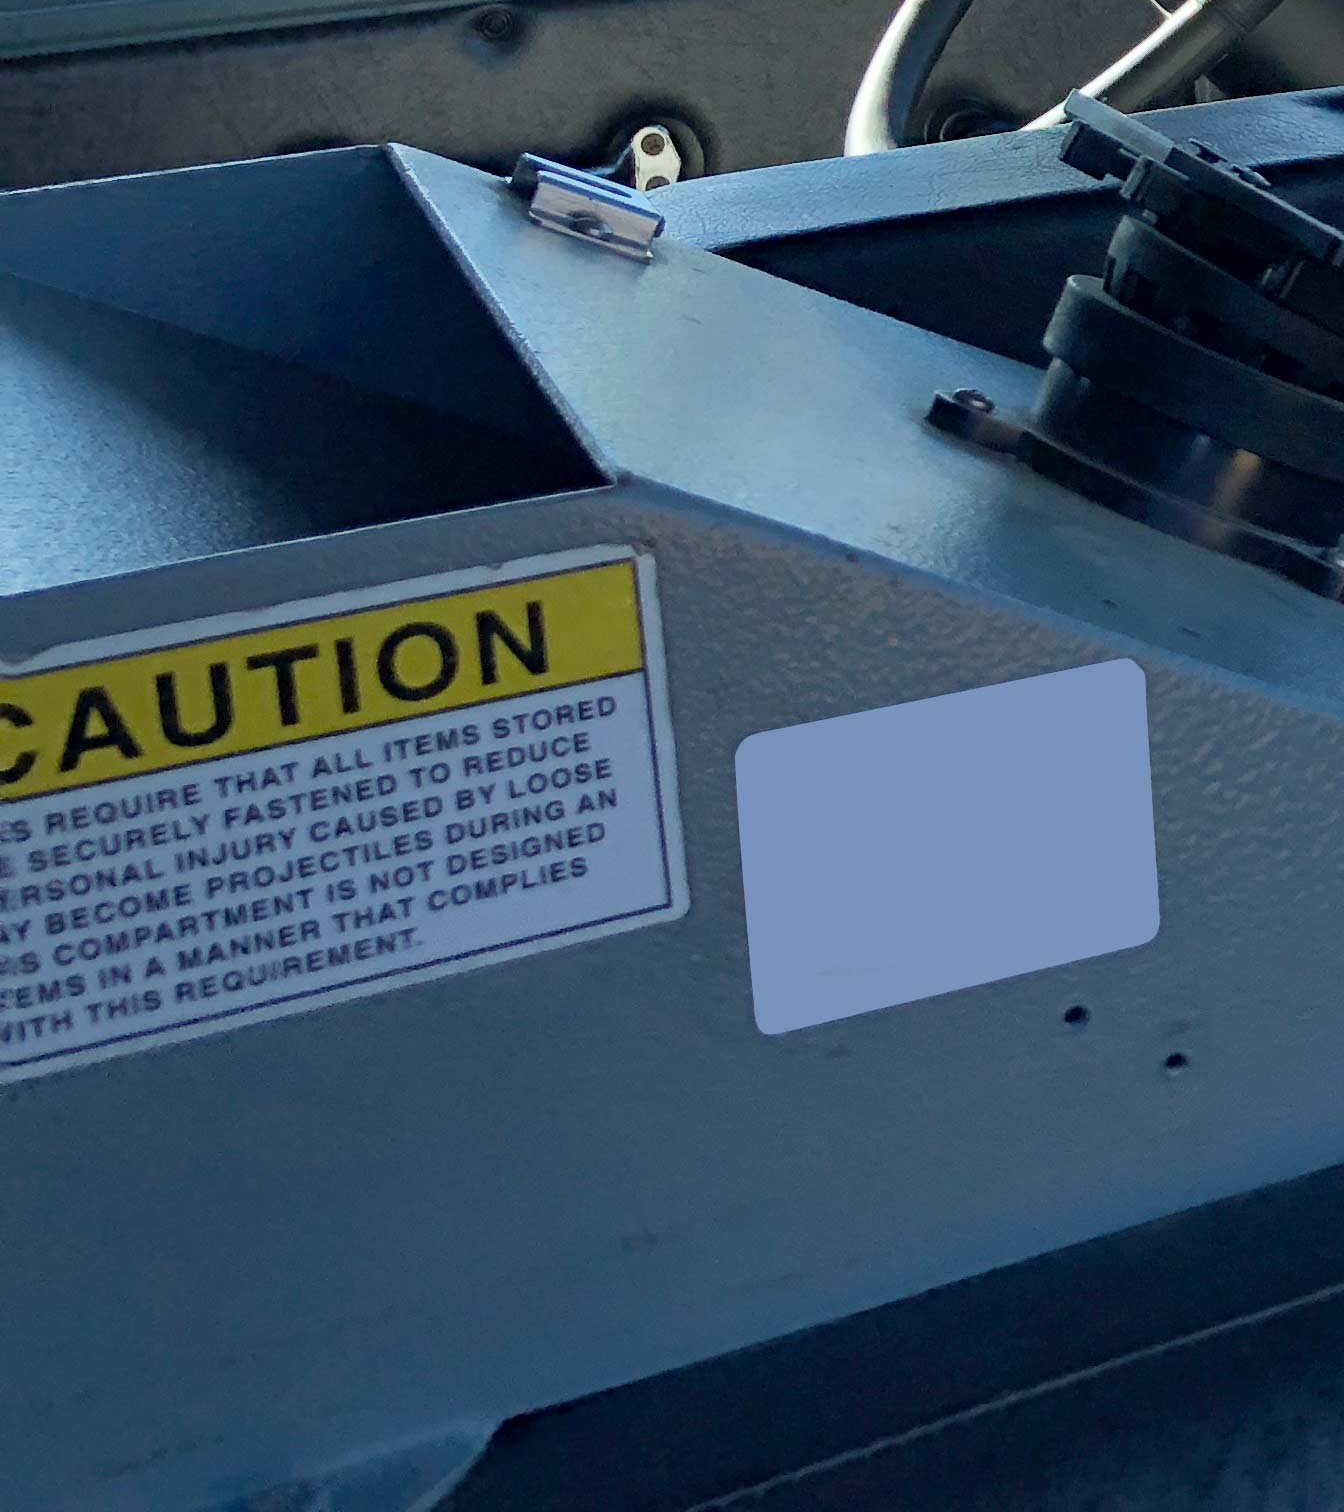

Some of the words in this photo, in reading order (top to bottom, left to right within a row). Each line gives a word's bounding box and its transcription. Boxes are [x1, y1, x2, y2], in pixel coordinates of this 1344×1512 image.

[0, 600, 549, 785] CAUTION
[28, 813, 211, 873] SECURELY
[224, 774, 397, 830] FASTENED
[409, 762, 451, 788] TO
[462, 732, 591, 777] REDUCE
[44, 783, 203, 835] REQUIRE
[214, 761, 299, 799] THAT
[312, 748, 373, 778] ALL
[383, 724, 481, 763] ITEMS
[491, 695, 617, 739] STORED
[175, 827, 296, 873] INJURY
[309, 795, 443, 842] CAUSED
[454, 782, 496, 811] BY
[508, 757, 613, 799] LOOSE
[44, 884, 193, 936] BECOME
[206, 830, 433, 899] PROJECTILES
[445, 799, 566, 845] DURING
[576, 788, 618, 814] AN
[53, 888, 314, 967] COMPARTMENT
[327, 879, 357, 904] IS
[370, 860, 435, 893] NOT
[446, 822, 606, 876] DESIGNED
[98, 963, 132, 989] IN
[145, 956, 166, 979] A
[176, 919, 321, 971] MANNER
[332, 896, 415, 934] THAT
[427, 856, 589, 910] COMPLIES
[84, 989, 161, 1024] THIS
[174, 927, 424, 1005] REQUIREMENT.
